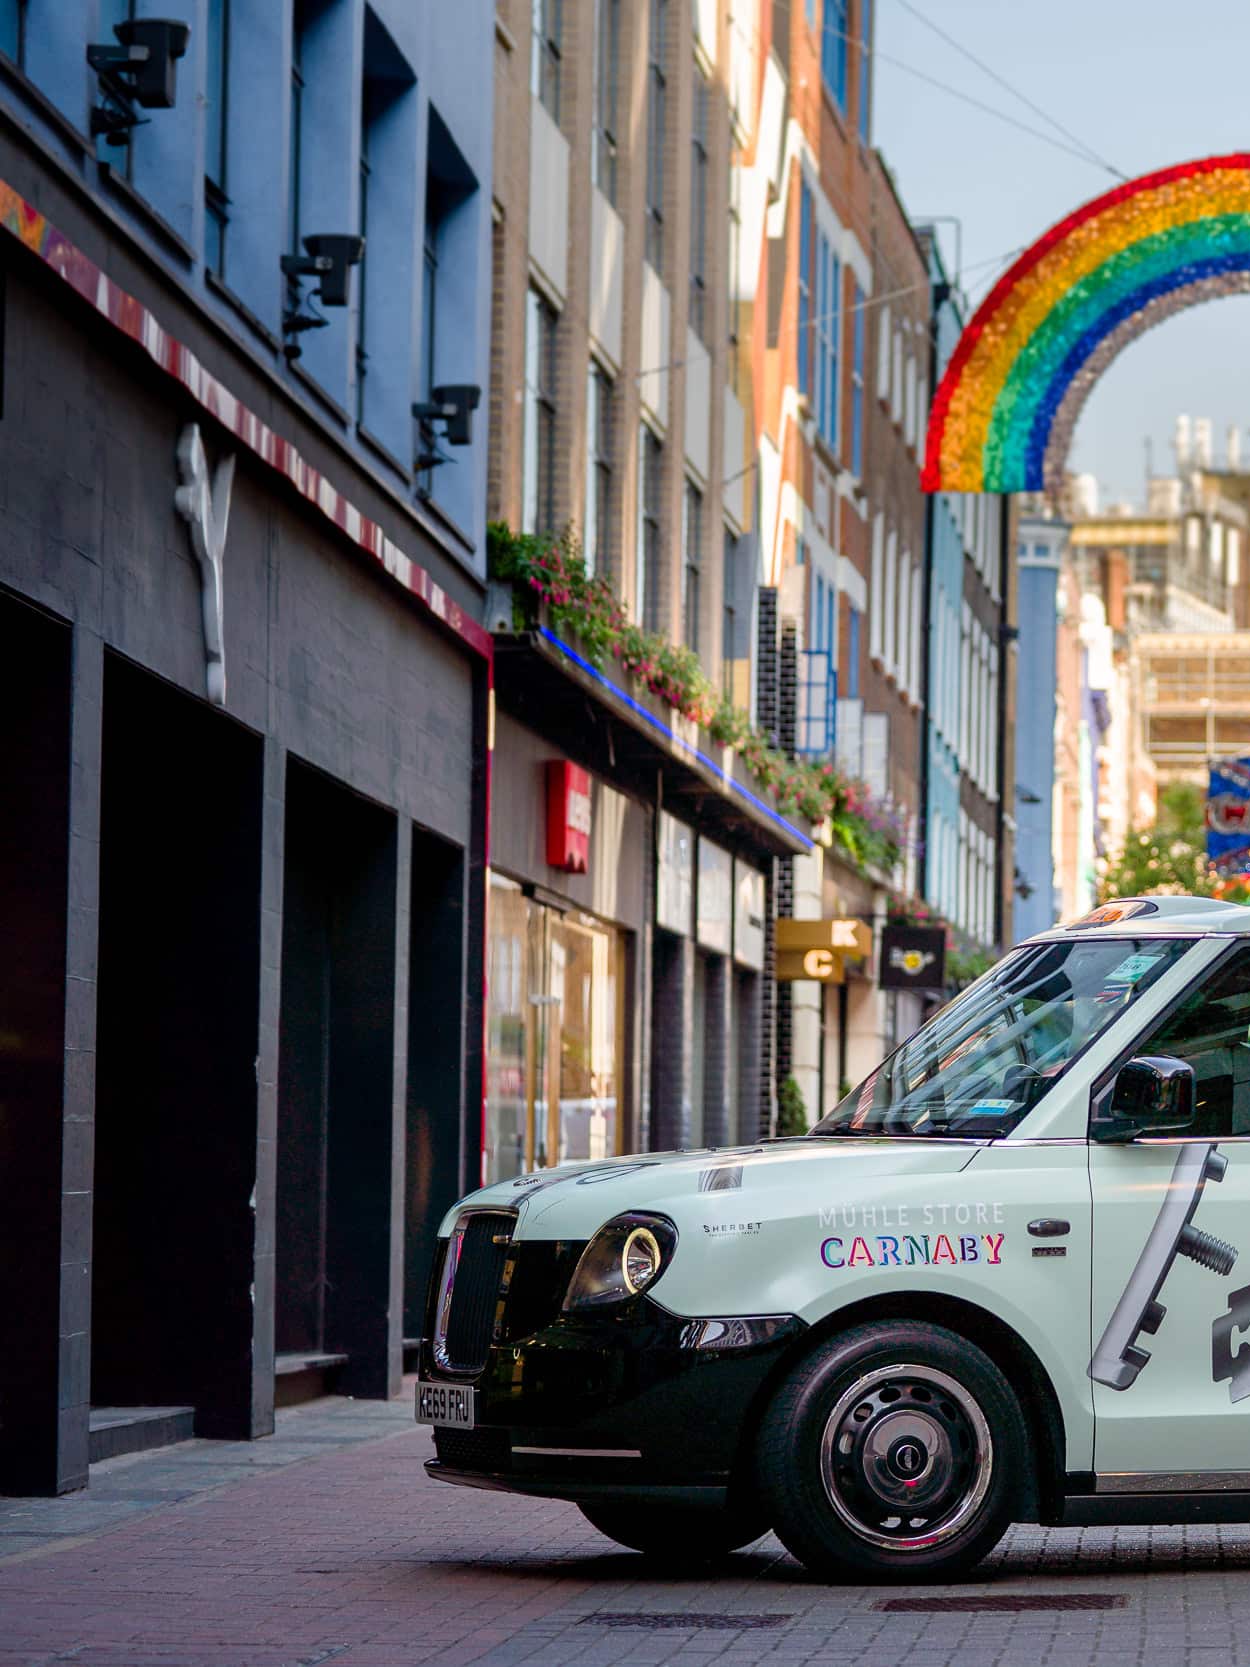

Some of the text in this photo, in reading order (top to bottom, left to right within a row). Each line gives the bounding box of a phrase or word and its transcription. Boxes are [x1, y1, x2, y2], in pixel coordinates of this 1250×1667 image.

[831, 919, 858, 947] K
[803, 949, 833, 977] C
[818, 1201, 1005, 1228] MÜHLE STORE
[820, 1232, 1005, 1268] CARNABY
[419, 1386, 469, 1422] KE69 FRU
